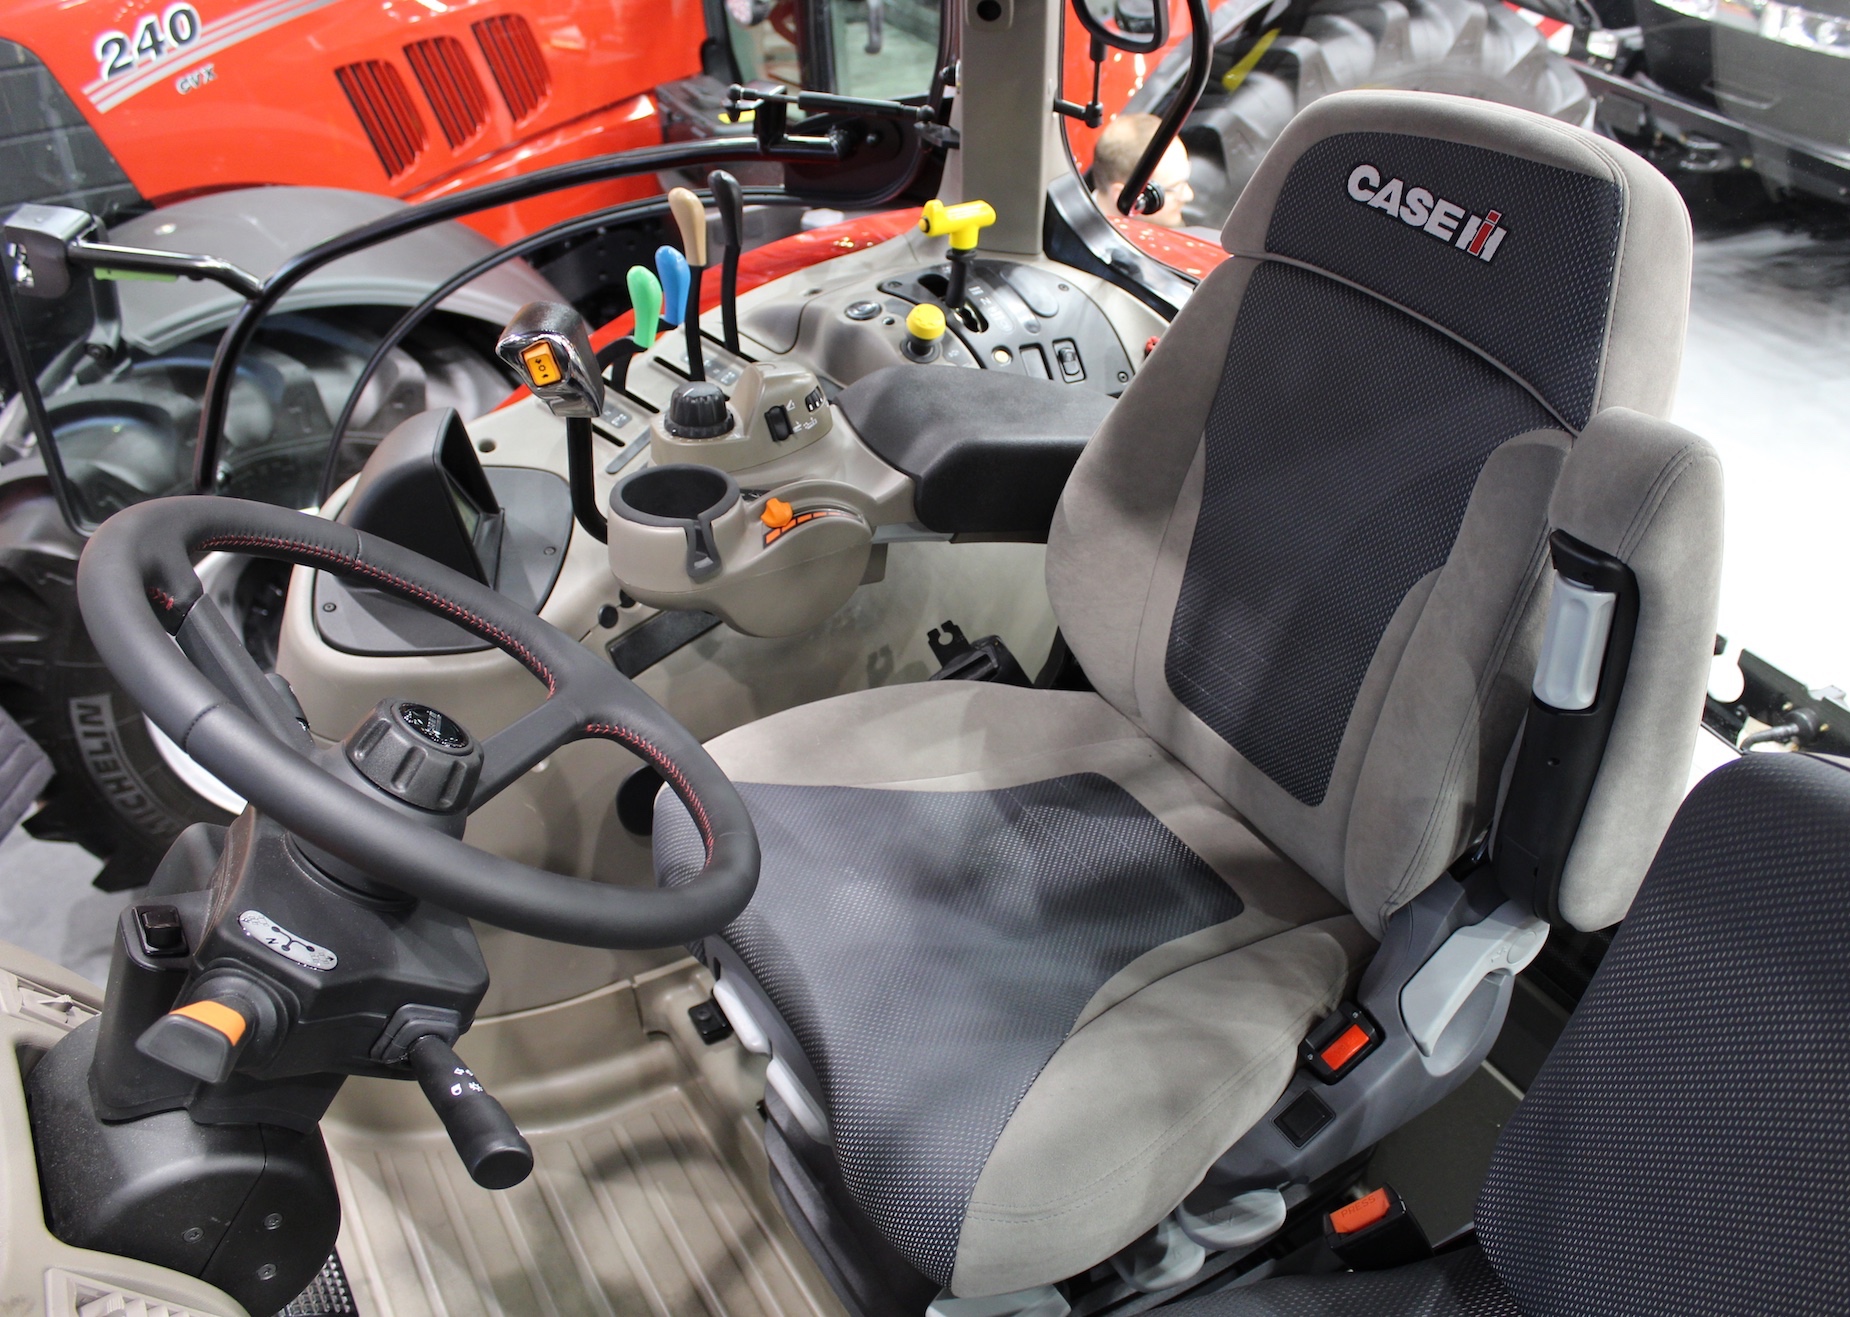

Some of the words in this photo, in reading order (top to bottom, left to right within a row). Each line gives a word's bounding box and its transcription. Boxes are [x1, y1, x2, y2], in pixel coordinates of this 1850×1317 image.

[96, 4, 201, 80] 240
[176, 63, 217, 94] CVX
[1347, 163, 1466, 242] CASE
[75, 702, 178, 836] MICHELIN
[1340, 1195, 1376, 1218] PRESS
